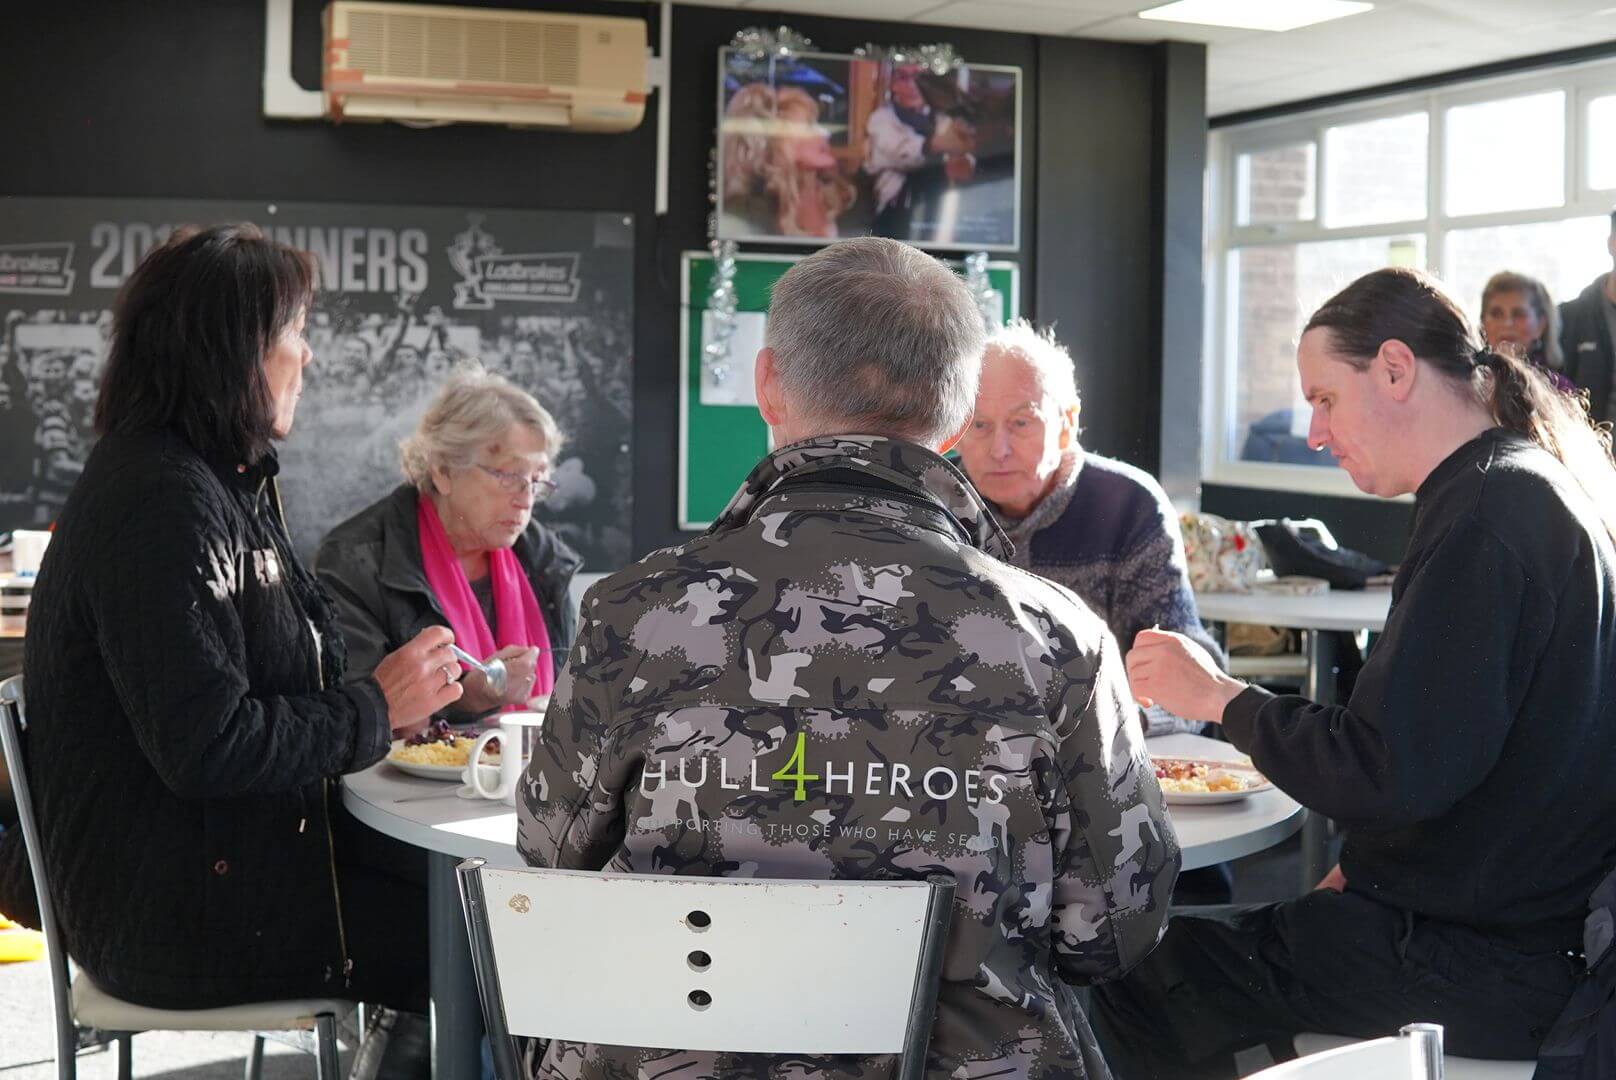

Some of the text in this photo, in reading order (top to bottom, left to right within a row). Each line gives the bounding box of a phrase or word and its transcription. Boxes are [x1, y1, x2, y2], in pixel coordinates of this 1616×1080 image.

[90, 222, 428, 293] 20 NERS
[485, 261, 567, 280] Ladbrokes
[637, 818, 999, 848] SPORTING THOSE WHO HAVE SED
